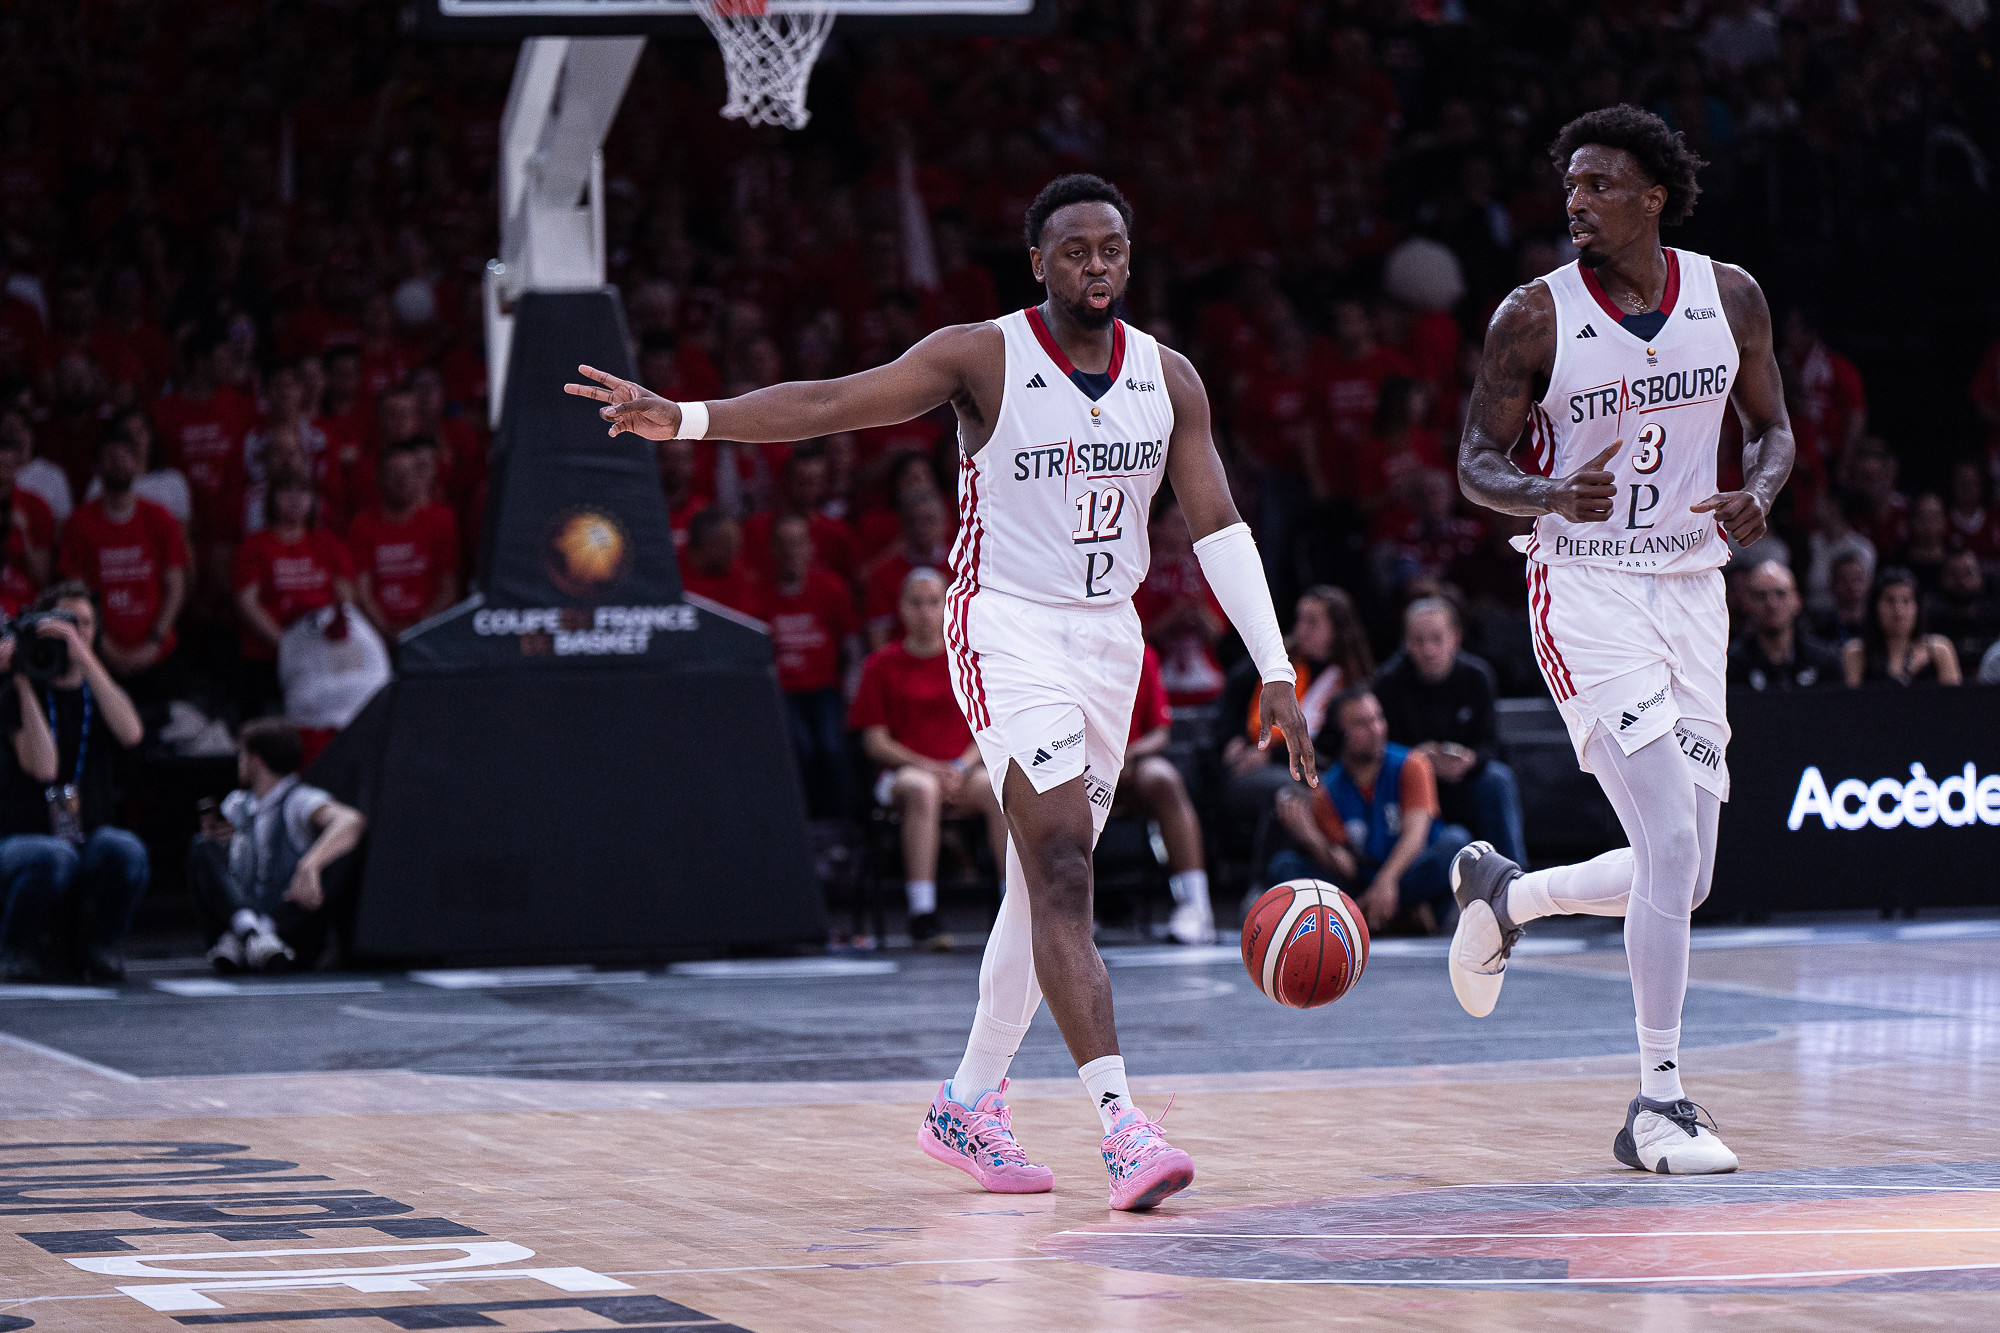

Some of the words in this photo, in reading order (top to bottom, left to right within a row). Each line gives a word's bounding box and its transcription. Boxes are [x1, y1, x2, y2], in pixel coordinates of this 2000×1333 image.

[1690, 309, 1716, 320] KLEIN
[1569, 365, 1727, 424] STRASBOURG
[1014, 438, 1162, 481] STRASBOURG
[1631, 423, 1667, 474] 3
[1072, 487, 1124, 545] 12
[1555, 535, 1627, 557] PIERRE
[1676, 733, 1720, 770] LEIN
[63, 1241, 636, 1311] DE
